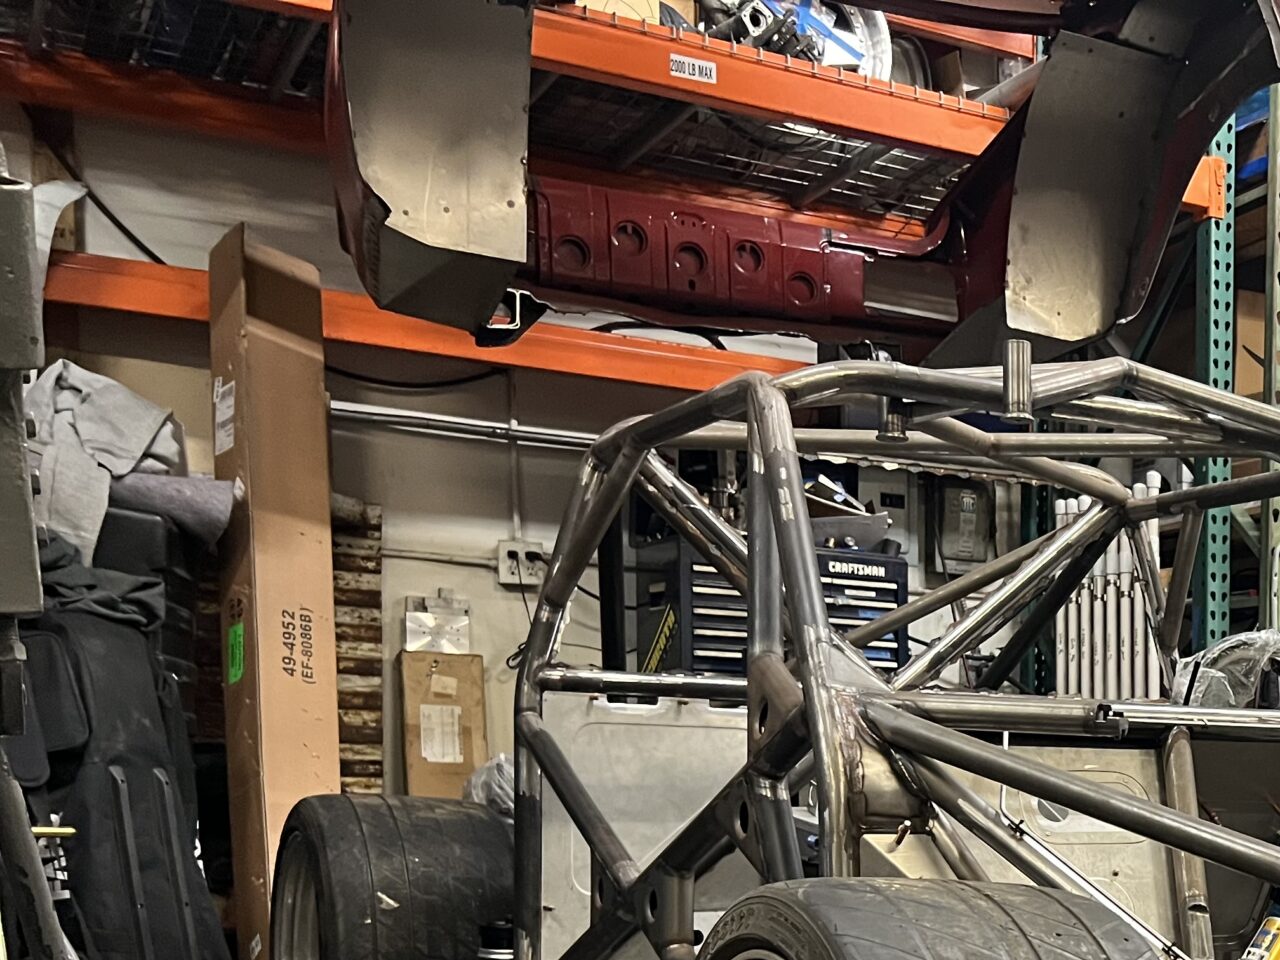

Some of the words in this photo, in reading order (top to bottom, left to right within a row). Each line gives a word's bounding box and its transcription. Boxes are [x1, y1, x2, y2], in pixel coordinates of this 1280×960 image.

[670, 59, 686, 74] 2000
[688, 62, 696, 76] LB
[698, 64, 713, 80] MAX
[828, 560, 886, 578] CRAFTSMAN
[281, 609, 297, 677] 49-4952
[300, 607, 317, 685] (EF-8086B)
